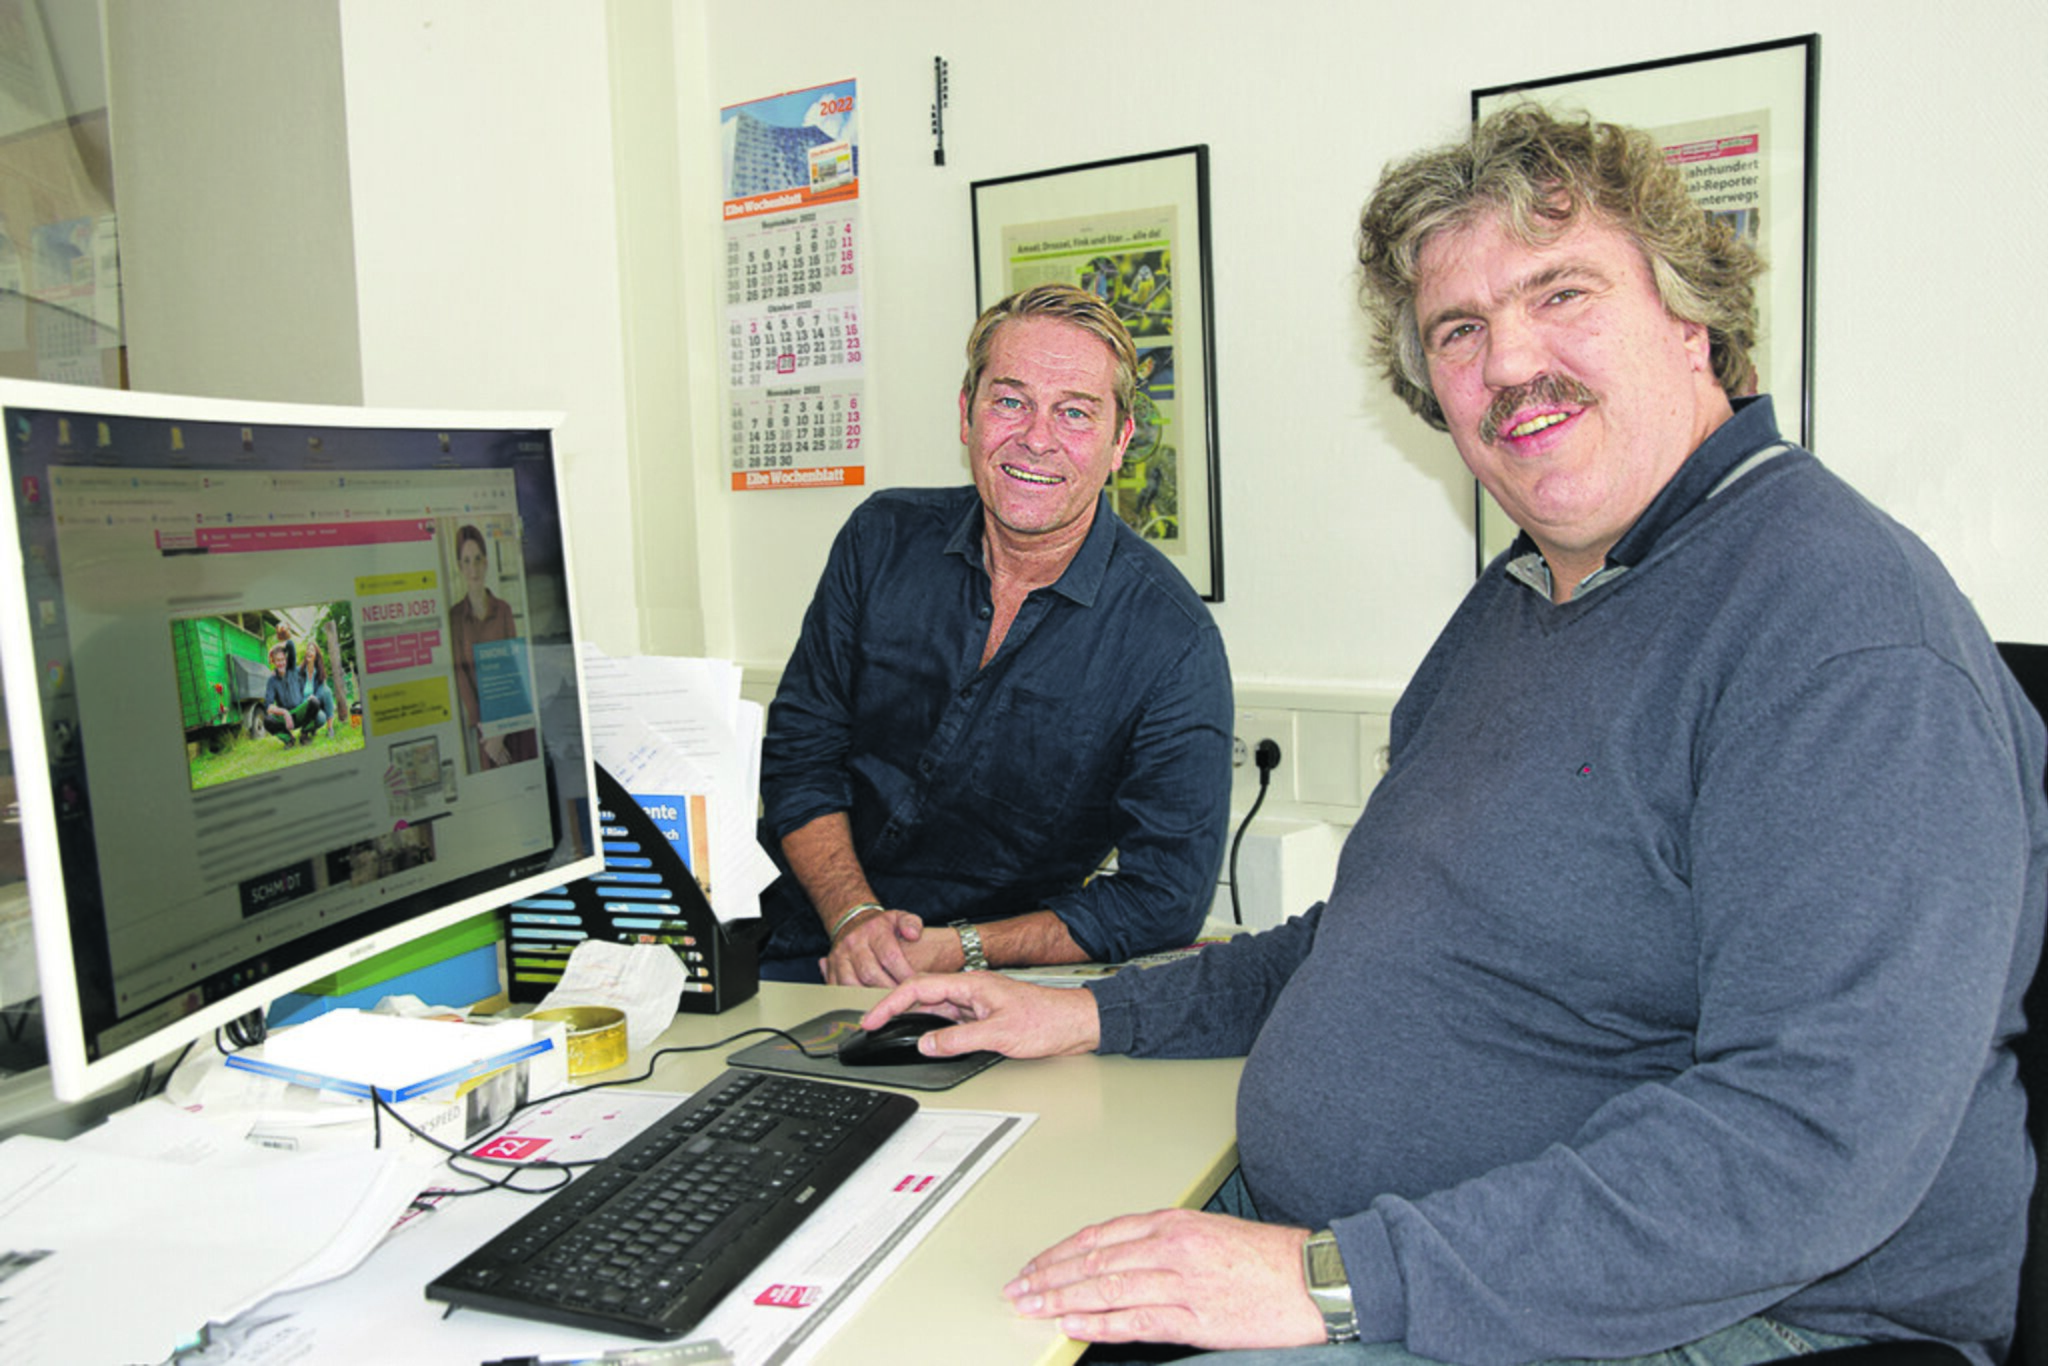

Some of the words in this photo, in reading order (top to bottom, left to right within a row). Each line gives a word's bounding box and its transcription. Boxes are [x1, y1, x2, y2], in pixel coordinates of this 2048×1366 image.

[820, 96, 853, 116] 2022
[725, 203, 744, 216] Elbe
[744, 193, 802, 213] Wochenblatt
[795, 231, 801, 242] 1
[811, 228, 818, 239] 2
[827, 225, 835, 237] 3
[844, 223, 852, 233] 4
[1090, 236, 1106, 245] und
[748, 251, 755, 262] 5
[763, 248, 770, 260] 6
[779, 246, 786, 257] 7
[795, 244, 802, 255] 8
[811, 241, 818, 253] 9
[825, 239, 837, 251] 10
[842, 237, 852, 248] 11
[746, 264, 758, 275] 12
[761, 262, 773, 273] 13
[777, 260, 788, 271] 14
[792, 257, 804, 268] 15
[809, 254, 820, 266] 16
[825, 252, 836, 263] 17
[841, 249, 853, 261] 18
[746, 277, 758, 288] 19
[777, 272, 788, 284] 21
[792, 270, 805, 282] 22
[808, 268, 821, 279] 23
[824, 265, 837, 278] 24
[840, 263, 854, 275] 25
[746, 290, 758, 302] 26
[761, 287, 773, 300] 27
[777, 286, 789, 298] 28
[792, 284, 805, 295] 29
[808, 281, 822, 293] 30
[751, 323, 757, 333] 3
[766, 321, 772, 331] 4
[781, 319, 788, 330] 5
[797, 316, 804, 328] 6
[813, 315, 819, 326] 7
[749, 335, 760, 347] 10
[764, 334, 775, 344] 11
[780, 332, 791, 343] 12
[796, 330, 808, 341] 13
[812, 328, 824, 339] 14
[829, 326, 840, 338] 15
[845, 324, 858, 336] 16
[750, 348, 760, 359] 17
[765, 346, 777, 357] 18
[781, 344, 793, 355] 19
[797, 343, 810, 355] 20
[813, 341, 825, 353] 21
[829, 339, 842, 351] 22
[847, 337, 860, 349] 23
[749, 360, 761, 372] 24
[765, 359, 777, 371] 25
[797, 356, 810, 367] 27
[813, 354, 827, 366] 28
[847, 351, 861, 363] 30
[783, 403, 790, 414] 2
[800, 401, 806, 413] 3
[816, 401, 823, 412] 4
[833, 400, 839, 410] 5
[850, 398, 857, 409] 6
[751, 418, 758, 429] 7
[767, 418, 774, 429] 8
[783, 416, 790, 427] 9
[796, 414, 809, 426] 10
[814, 414, 824, 425] 11
[830, 412, 842, 424] 12
[847, 411, 860, 423] 13
[749, 431, 760, 442] 14
[765, 430, 776, 441] 15
[796, 428, 808, 439] 17
[813, 427, 825, 438] 18
[830, 426, 842, 437] 19
[846, 425, 860, 437] 20
[749, 444, 760, 455] 21
[764, 443, 776, 454] 22
[780, 442, 792, 453] 23
[796, 441, 809, 452] 24
[812, 440, 825, 451] 25
[846, 438, 860, 450] 27
[749, 457, 760, 468] 28
[764, 455, 776, 467] 29
[780, 455, 792, 466] 30
[746, 471, 770, 485] Elbe
[770, 467, 844, 484] Wochenblatt
[362, 603, 405, 623] NEUER
[407, 599, 436, 617] JOB?
[487, 1139, 531, 1156] 22
